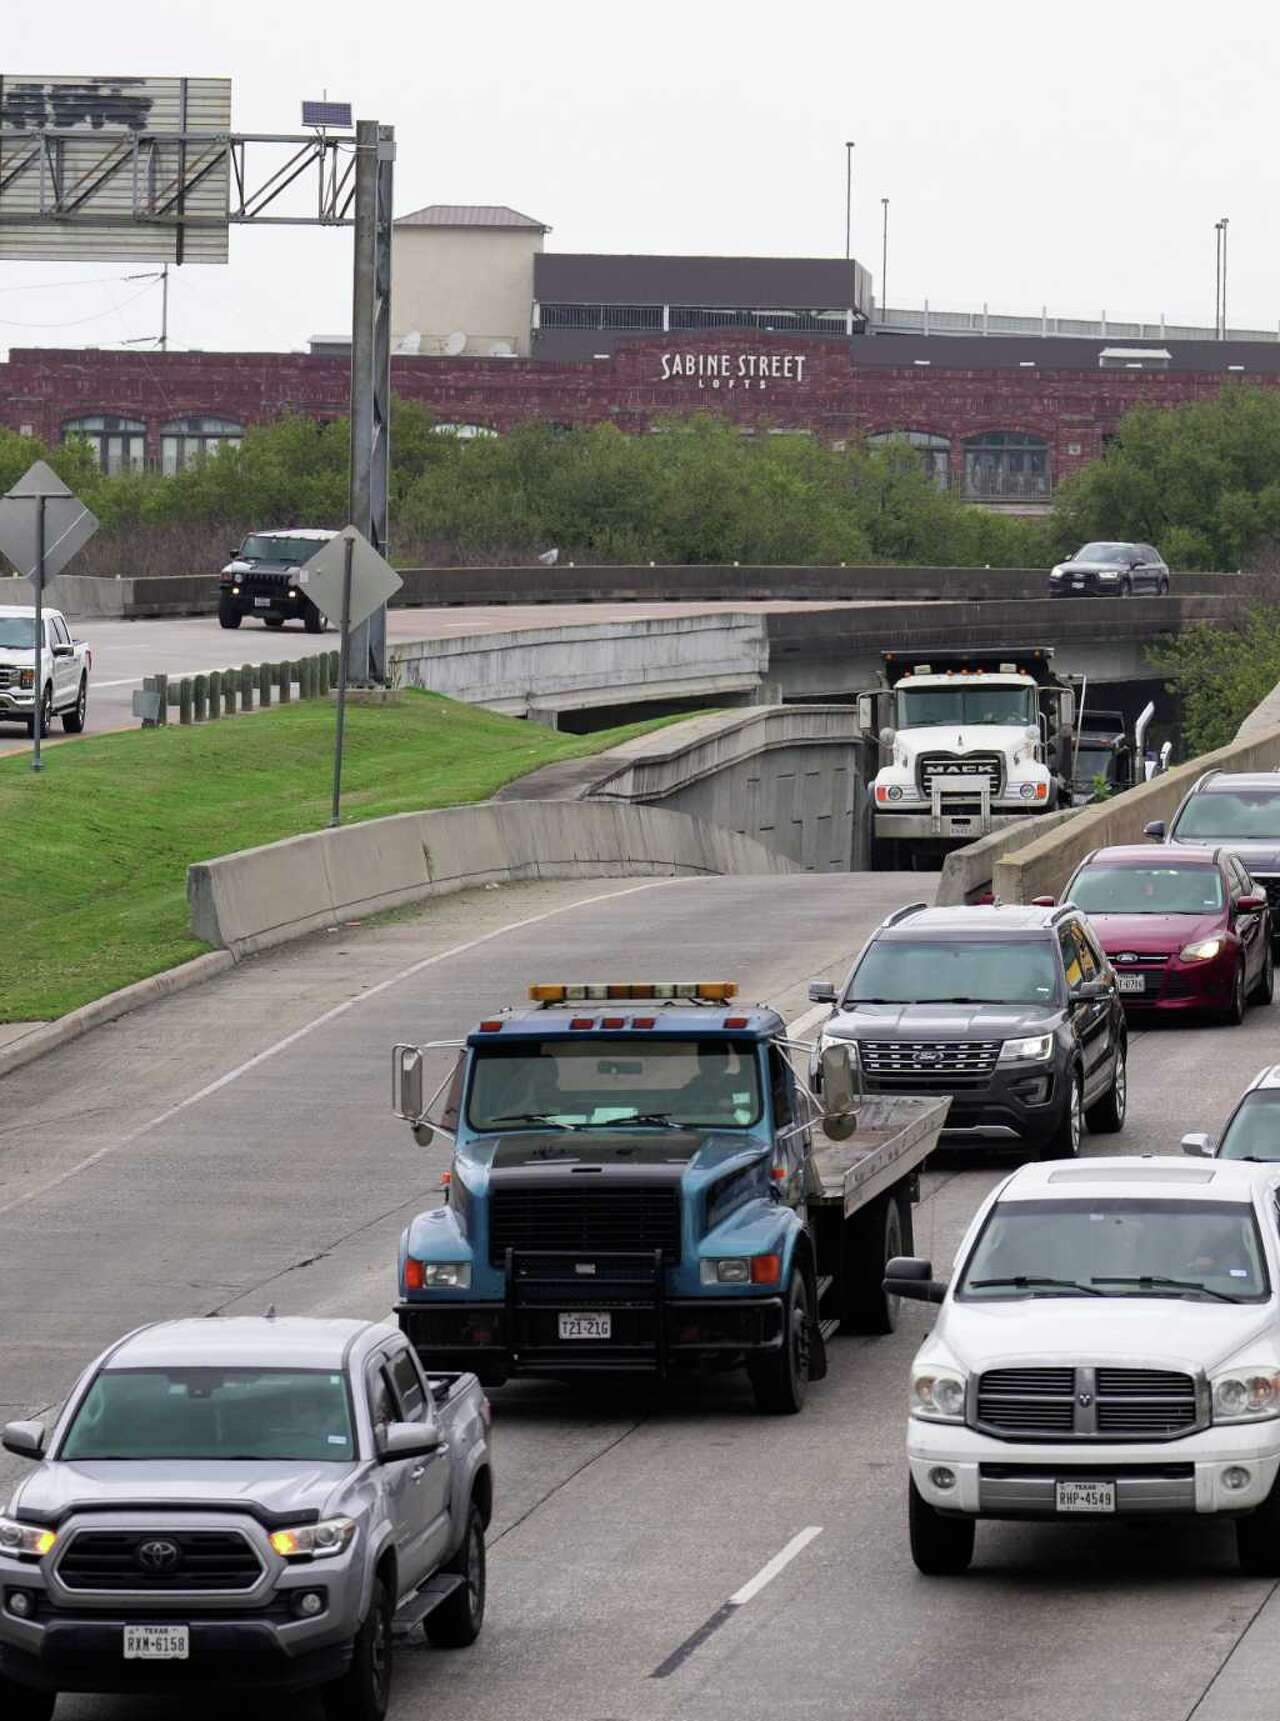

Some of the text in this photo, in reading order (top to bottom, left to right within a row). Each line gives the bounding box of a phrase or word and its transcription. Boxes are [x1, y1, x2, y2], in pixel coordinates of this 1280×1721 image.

[661, 353, 806, 382] SABINE STREET
[698, 379, 767, 389] LOFTS
[926, 765, 995, 774] MACK
